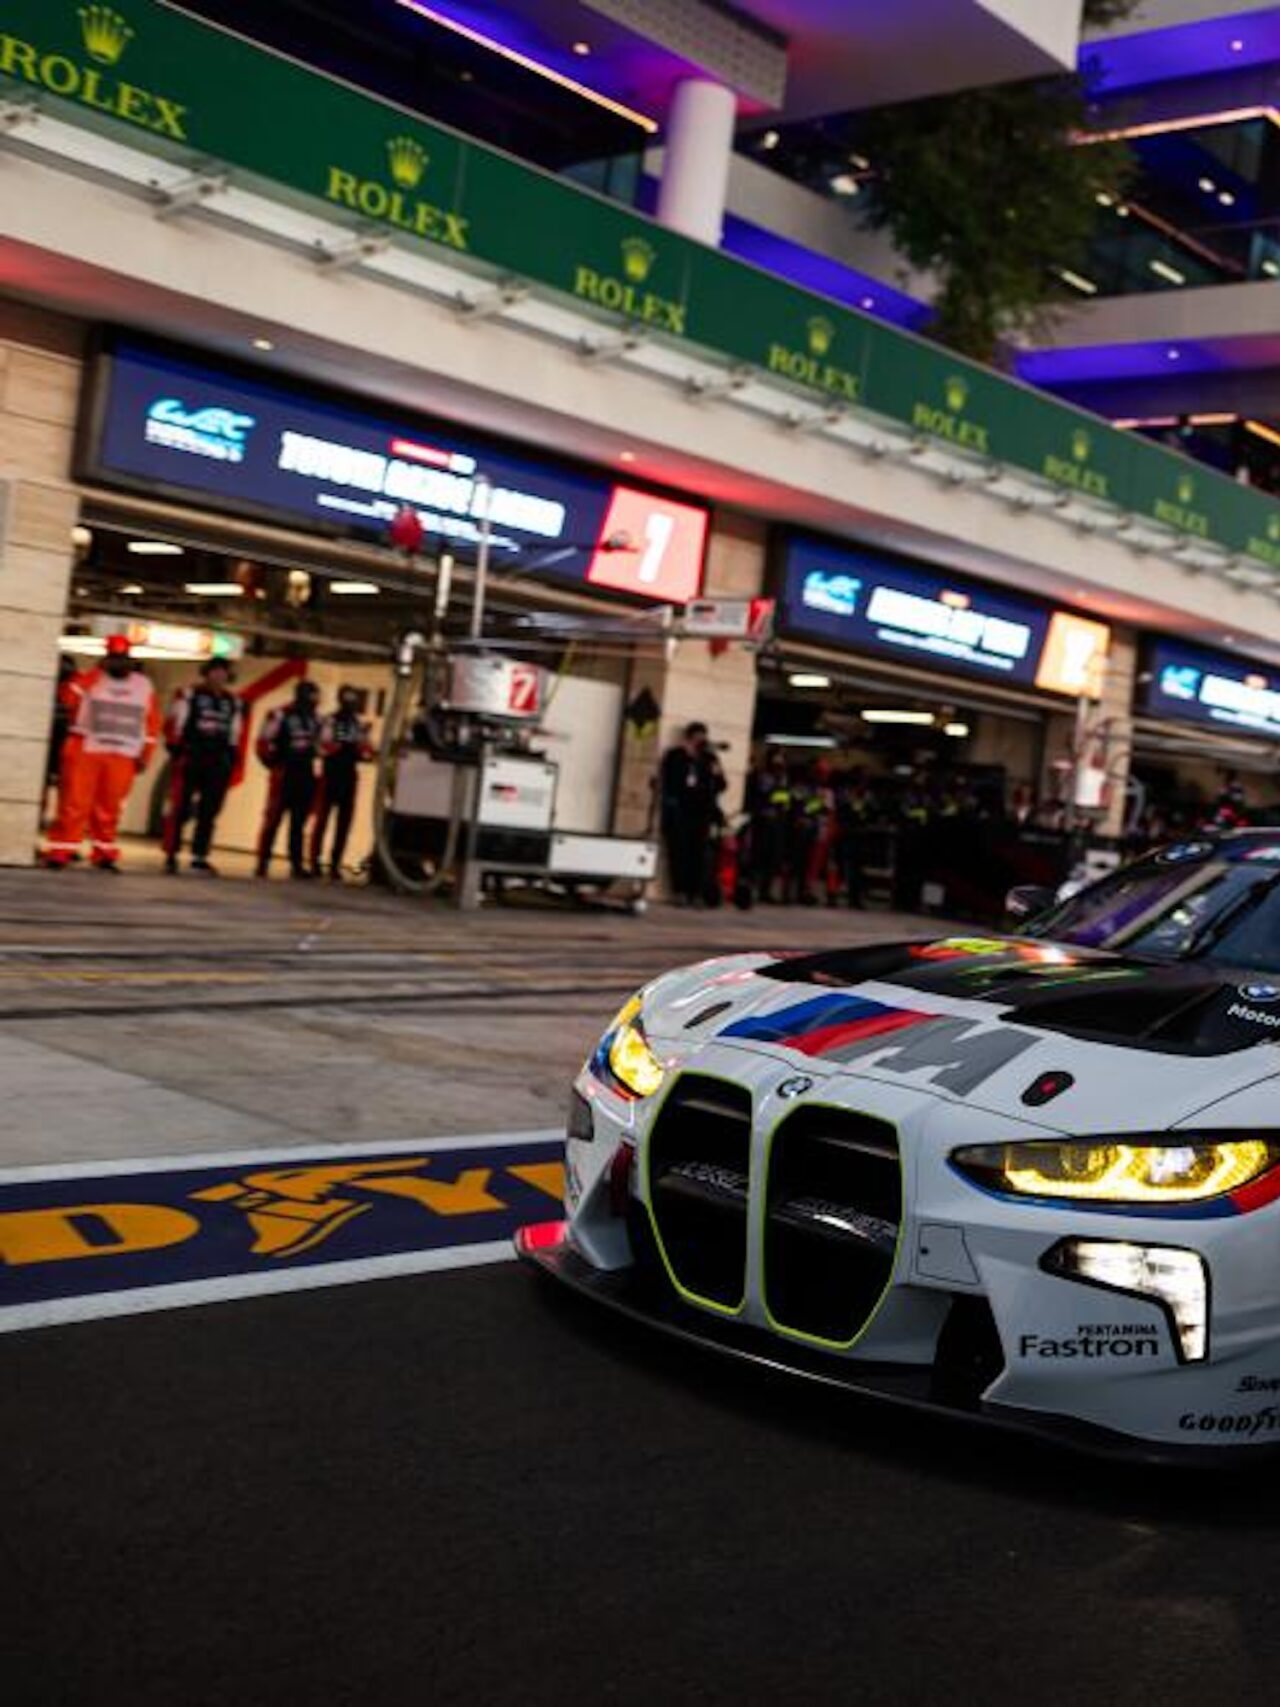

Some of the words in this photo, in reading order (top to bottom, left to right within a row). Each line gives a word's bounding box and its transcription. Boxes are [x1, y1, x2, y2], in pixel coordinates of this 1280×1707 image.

[0, 33, 187, 142] ROLEX
[327, 166, 470, 250] ROLEX
[575, 266, 687, 334] ROLEX
[769, 344, 860, 399] ROLEX
[511, 672, 538, 709] 7
[1019, 1334, 1159, 1358] Fastron
[1077, 1323, 1158, 1337] PERTAMINA
